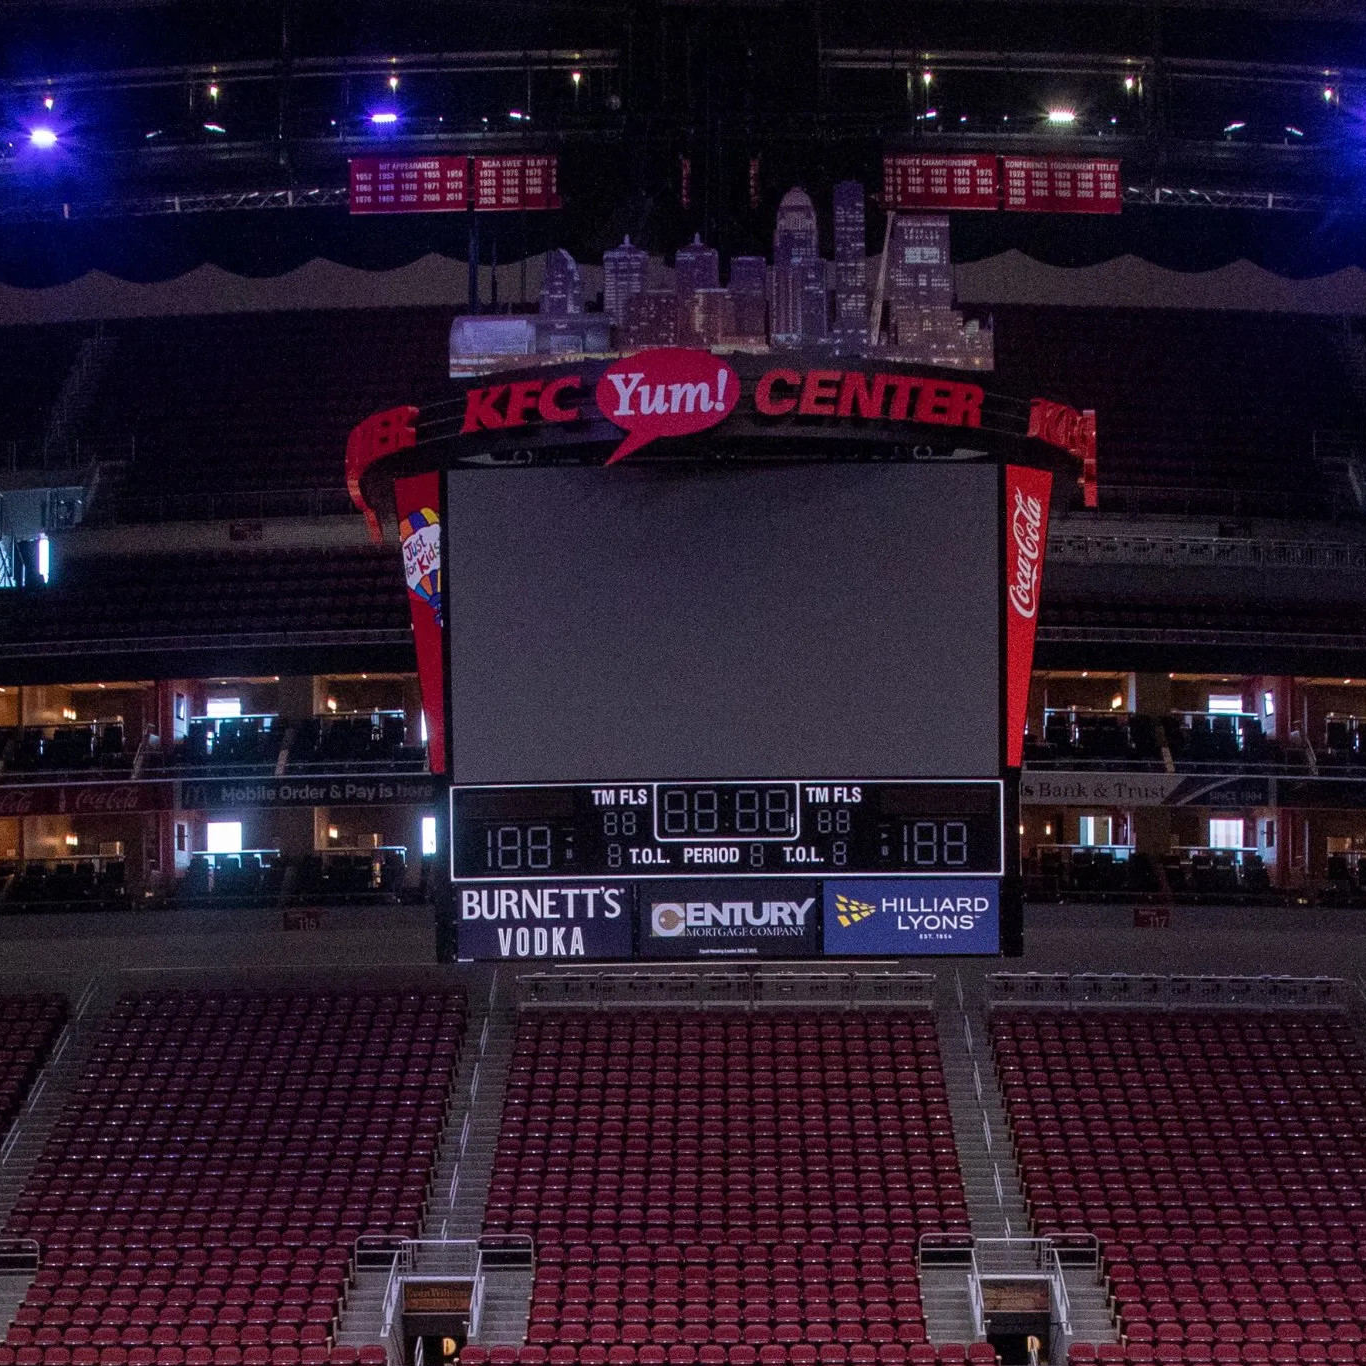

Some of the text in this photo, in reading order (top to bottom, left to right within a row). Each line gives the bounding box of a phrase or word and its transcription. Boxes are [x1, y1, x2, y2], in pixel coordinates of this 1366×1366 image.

[392, 161, 440, 170] APPEARANCES
[482, 160, 501, 168] NCAA
[922, 159, 978, 167] CHAMPIONSHIPS
[1097, 163, 1119, 171] TITLES
[461, 367, 985, 435] KFC Yum! CENTER
[404, 533, 427, 562] Just
[1010, 486, 1041, 618] Coca-Cola
[221, 786, 276, 801] Mobile
[279, 785, 326, 801] Order
[329, 784, 343, 798] &
[345, 784, 374, 802] Pay
[379, 783, 393, 798] is
[592, 789, 648, 805] TM FLS
[805, 787, 862, 803] TM FLS
[1039, 782, 1166, 798] Bank & Trust
[629, 846, 825, 864] T.O.L. PERIOD T.O.L.
[461, 888, 622, 920] BURNETT'S
[882, 897, 989, 912] HILLIARD
[652, 898, 816, 937] CENTURY
[898, 915, 974, 930] LYONS
[1148, 916, 1167, 928] 117
[686, 926, 806, 937] MORTGAGE COMPANY
[498, 926, 585, 957] VODKA
